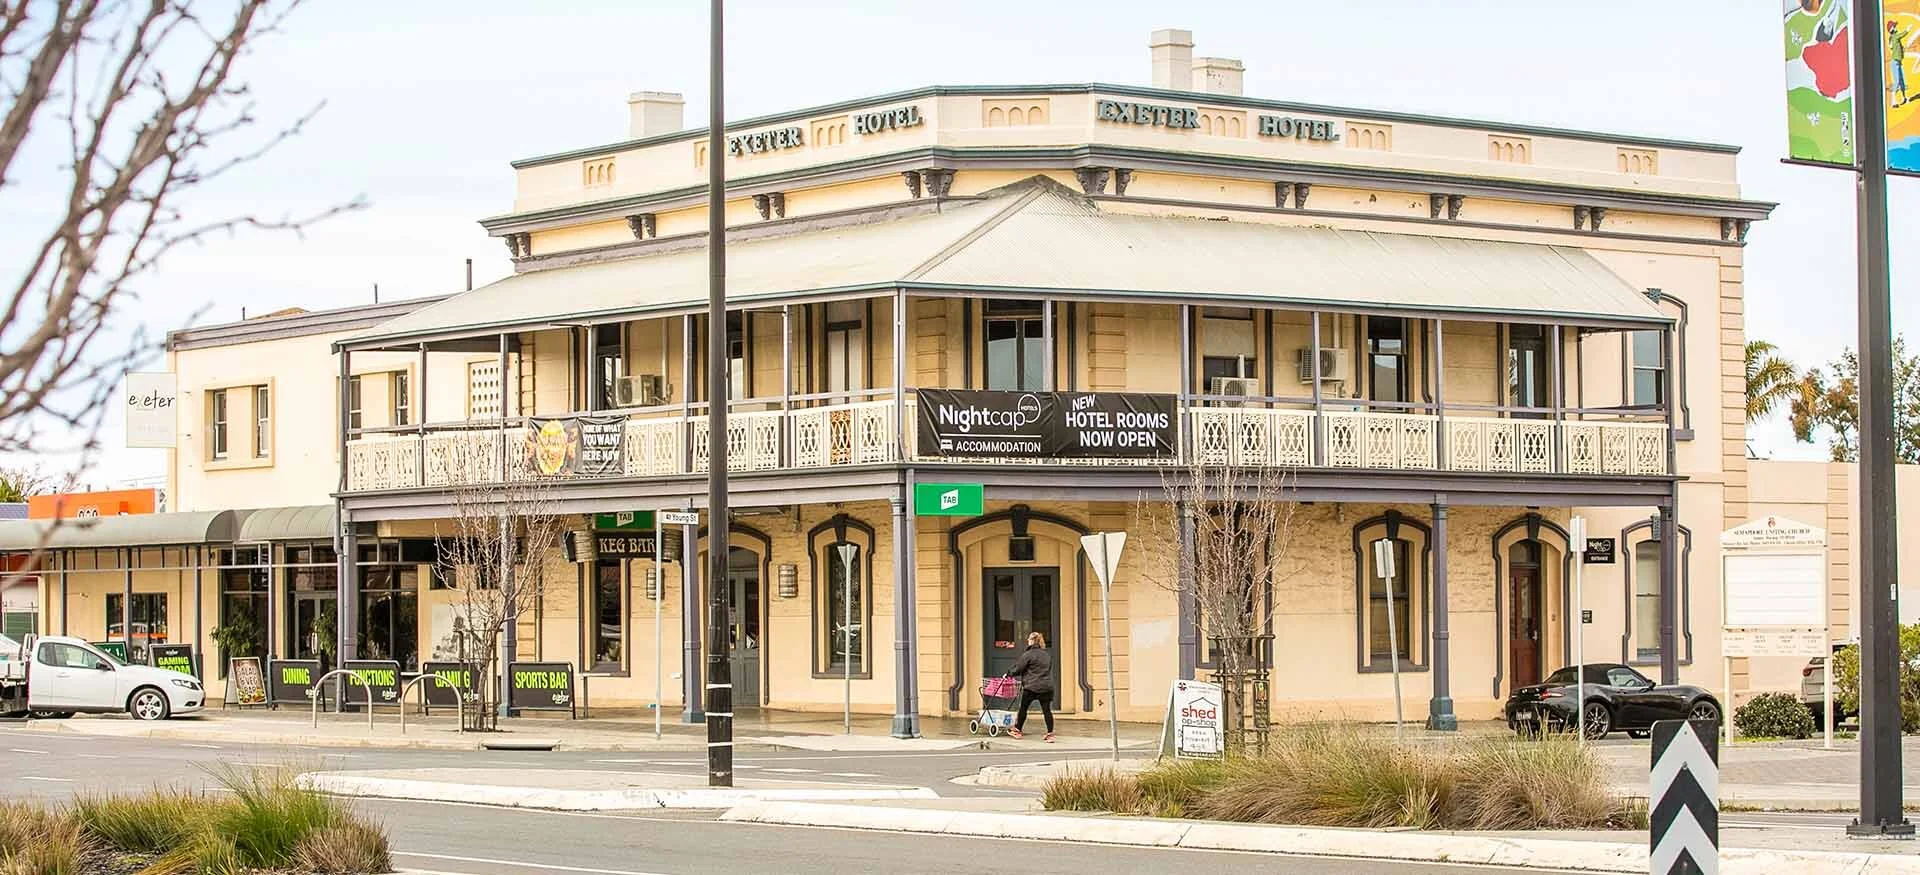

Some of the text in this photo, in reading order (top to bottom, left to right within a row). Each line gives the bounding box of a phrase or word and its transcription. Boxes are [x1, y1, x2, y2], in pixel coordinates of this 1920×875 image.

[1098, 100, 1341, 142] EXETER HOTEL
[728, 105, 924, 157] EXETER HOTEL
[1072, 394, 1096, 412] NEW
[939, 404, 1026, 433] Nightcap
[1065, 411, 1169, 429] HOTEL ROOMS
[603, 423, 621, 433] WHAT
[583, 434, 620, 447] YOU WANT
[1080, 430, 1156, 448] NOW OPEN
[956, 440, 1041, 454] ACCOMMODATION
[582, 450, 601, 461] HERE
[943, 495, 957, 505] TAB
[618, 513, 633, 521] TAB
[672, 514, 690, 523] Young
[600, 538, 656, 553] KEG BAR
[158, 656, 189, 666] GAMING
[282, 667, 311, 685] DINING
[435, 670, 471, 688] GAMIG
[515, 671, 568, 689] SPORTS BAR
[1182, 705, 1217, 720] shed
[1182, 718, 1217, 728] op-shop
